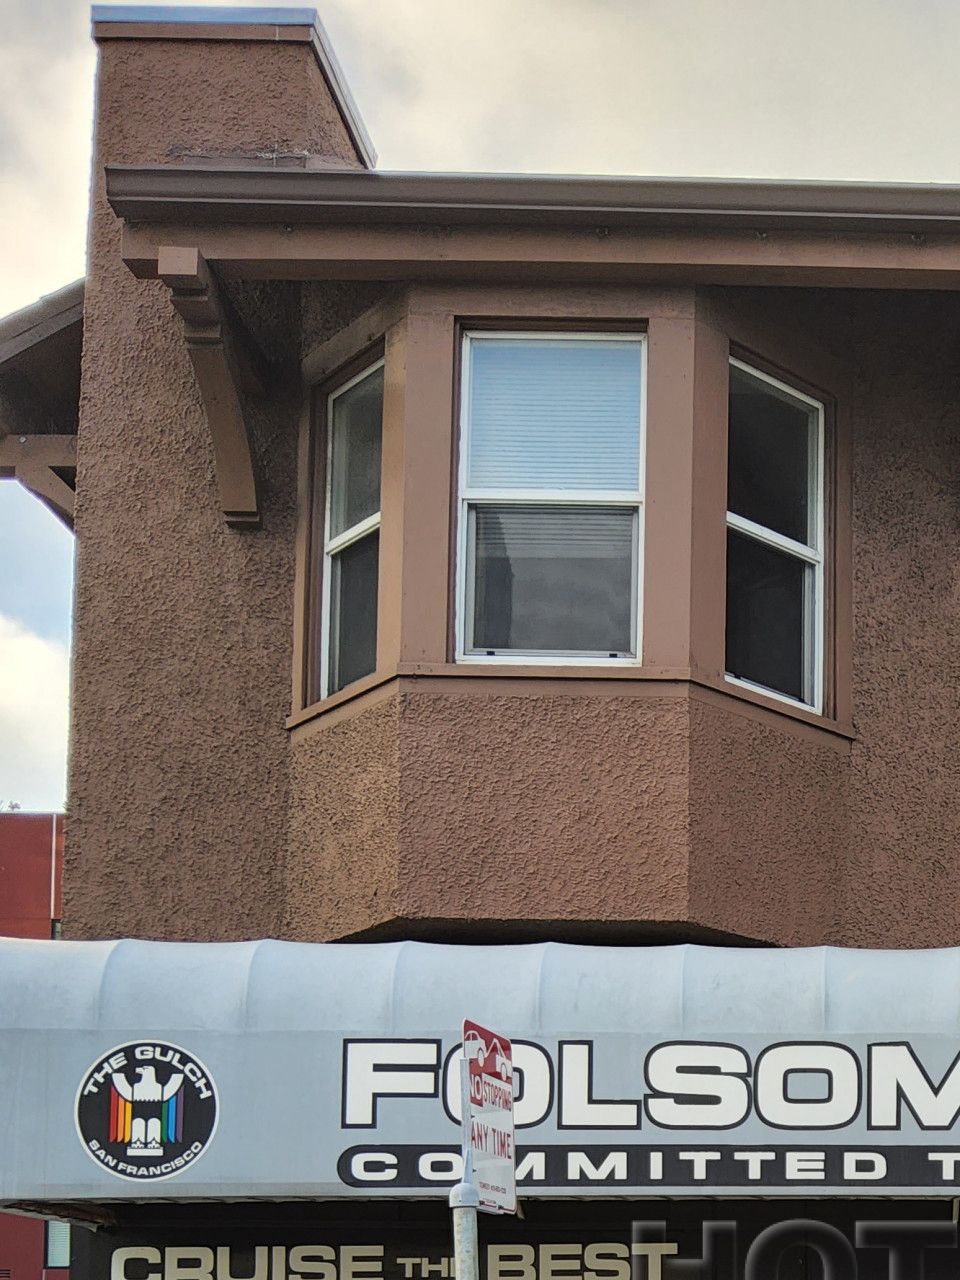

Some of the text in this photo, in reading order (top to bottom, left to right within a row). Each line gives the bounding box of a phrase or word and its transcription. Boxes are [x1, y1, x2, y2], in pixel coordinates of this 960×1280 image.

[83, 1046, 213, 1099] THE GULCH
[470, 1073, 482, 1101] NO
[483, 1080, 512, 1113] STOPPING
[471, 1120, 512, 1160] ANY TIME
[88, 1139, 202, 1176] SAN FRANCISCO
[351, 1151, 887, 1182] COMMITTED
[396, 1257, 456, 1278] TH
